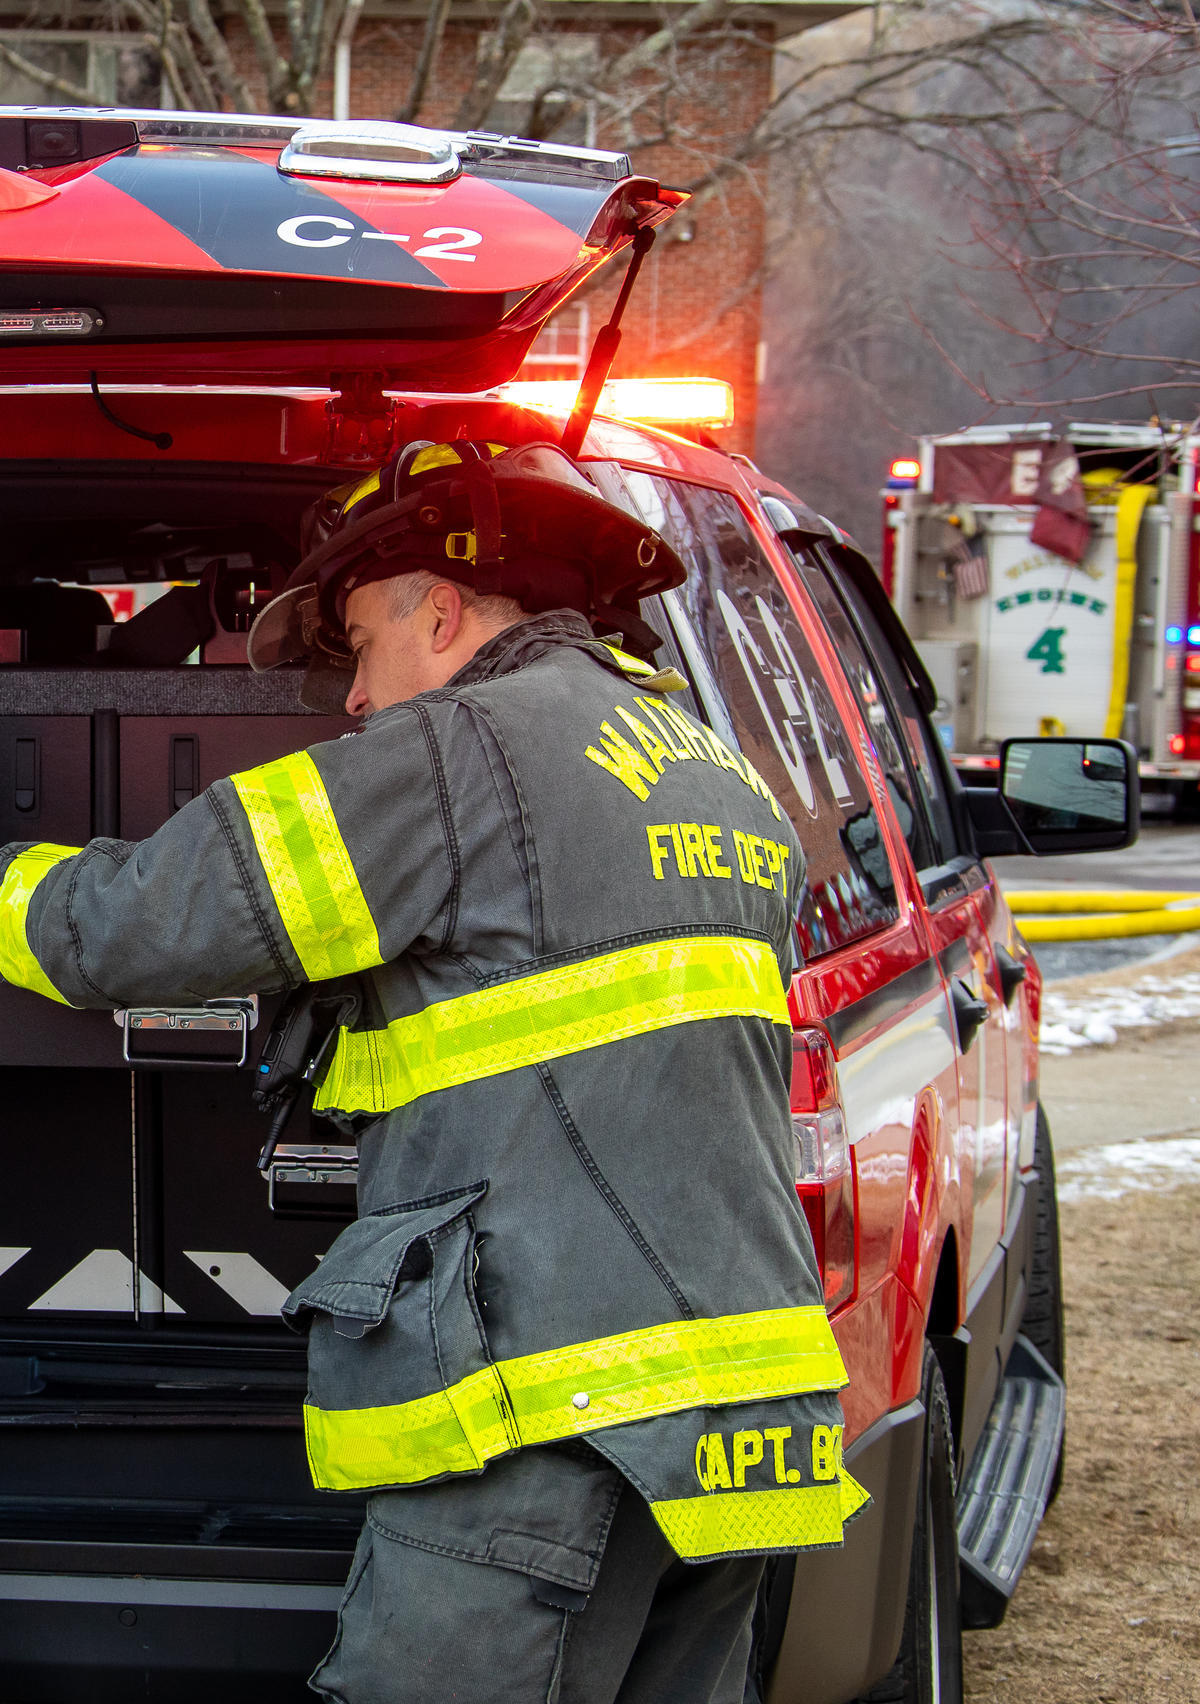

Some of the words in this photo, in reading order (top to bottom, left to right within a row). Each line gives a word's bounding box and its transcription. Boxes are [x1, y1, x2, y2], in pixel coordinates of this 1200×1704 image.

[277, 215, 483, 263] C-2
[996, 588, 1108, 616] ENGINE
[1025, 626, 1067, 674] 4
[645, 822, 732, 880] FIRE
[732, 828, 790, 898] DEPT
[695, 1426, 801, 1491] CAPT.
